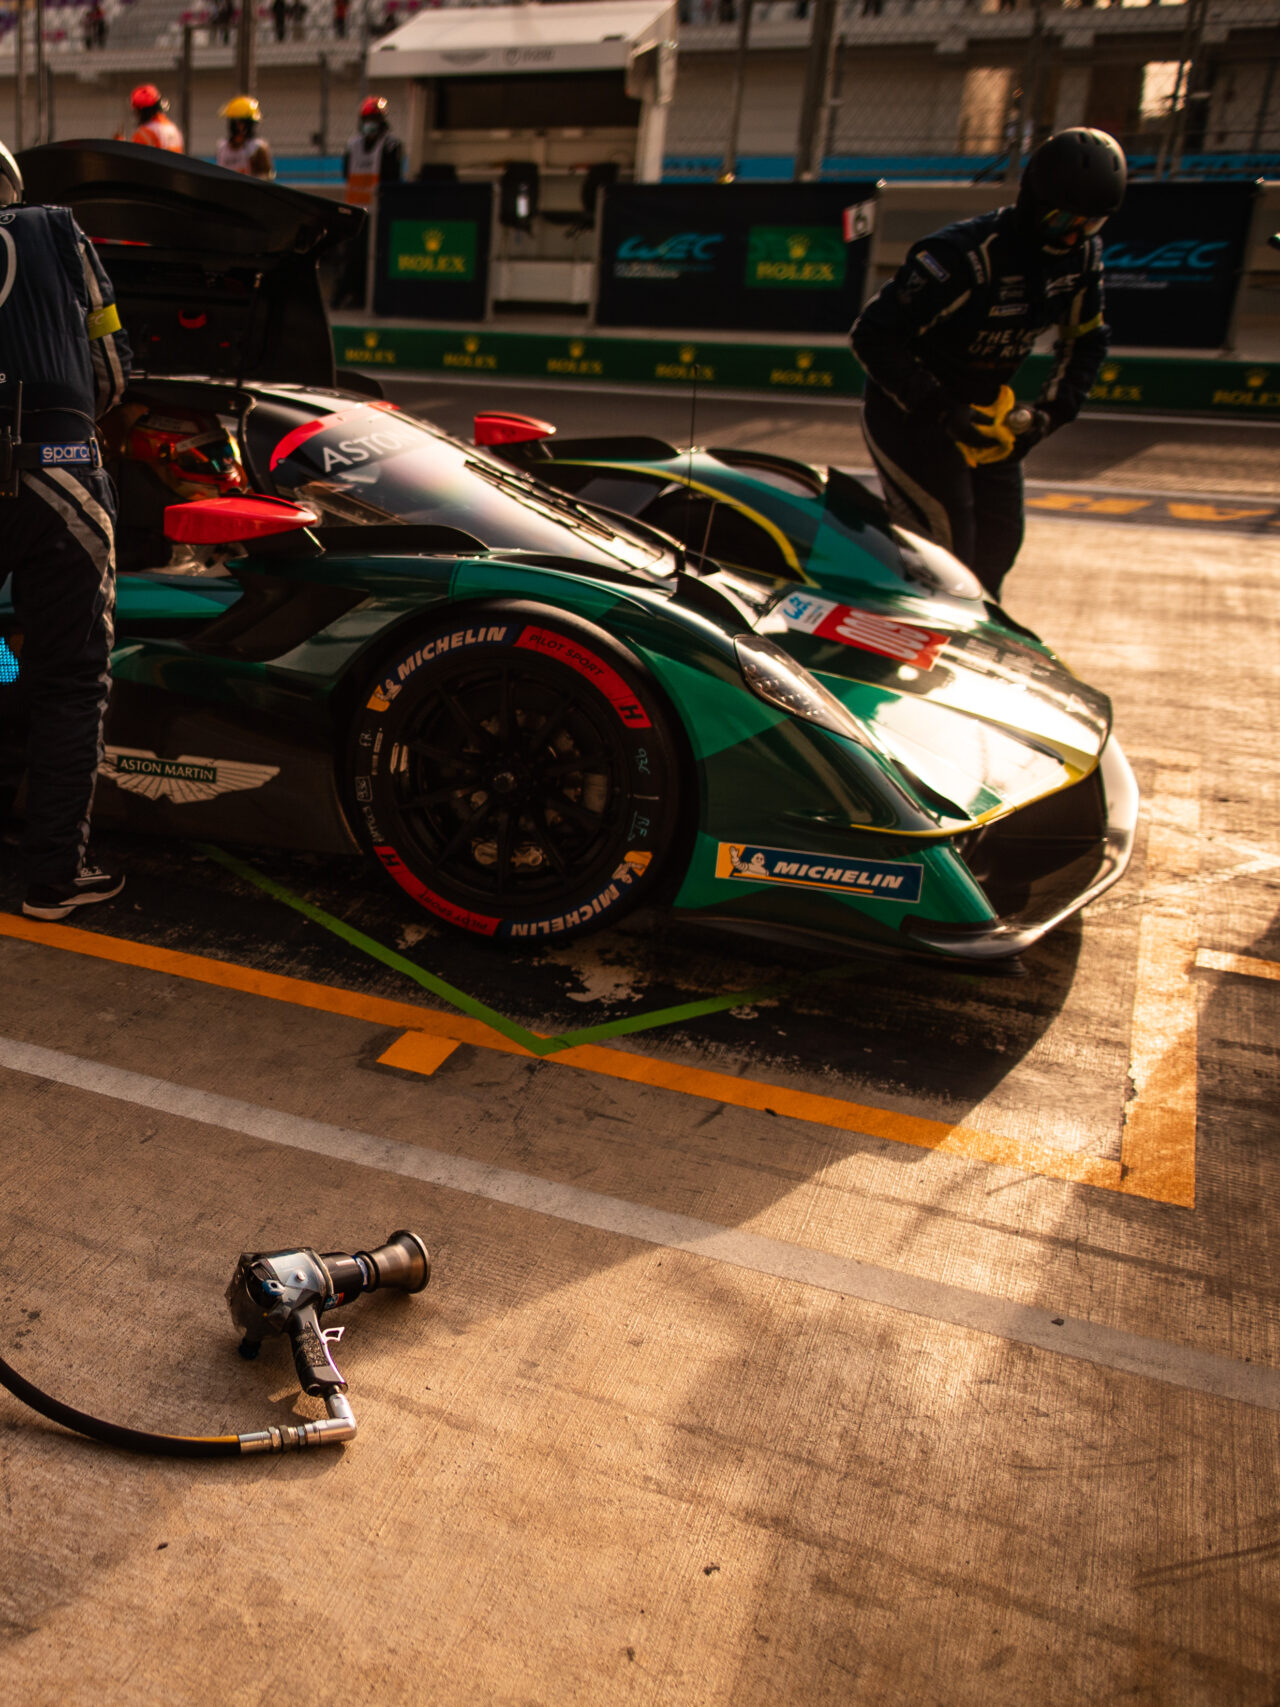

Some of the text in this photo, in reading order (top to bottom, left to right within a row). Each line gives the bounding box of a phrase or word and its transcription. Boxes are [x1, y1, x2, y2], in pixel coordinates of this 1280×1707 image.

[616, 232, 725, 261] WEC
[1100, 240, 1231, 269] WEC
[397, 254, 467, 273] ROLEX
[755, 261, 835, 281] ROLEX
[443, 353, 497, 370] ROLEX
[547, 358, 603, 375] ROLEX
[655, 363, 716, 381] ROLEX
[769, 369, 834, 388] ROLEX
[323, 431, 404, 473] ASTO
[396, 625, 508, 681] MICHELIN
[620, 703, 644, 720] H
[120, 757, 215, 780] ASTON MARTIN
[773, 860, 904, 889] MICHELIN
[510, 884, 620, 937] MICHELIN
